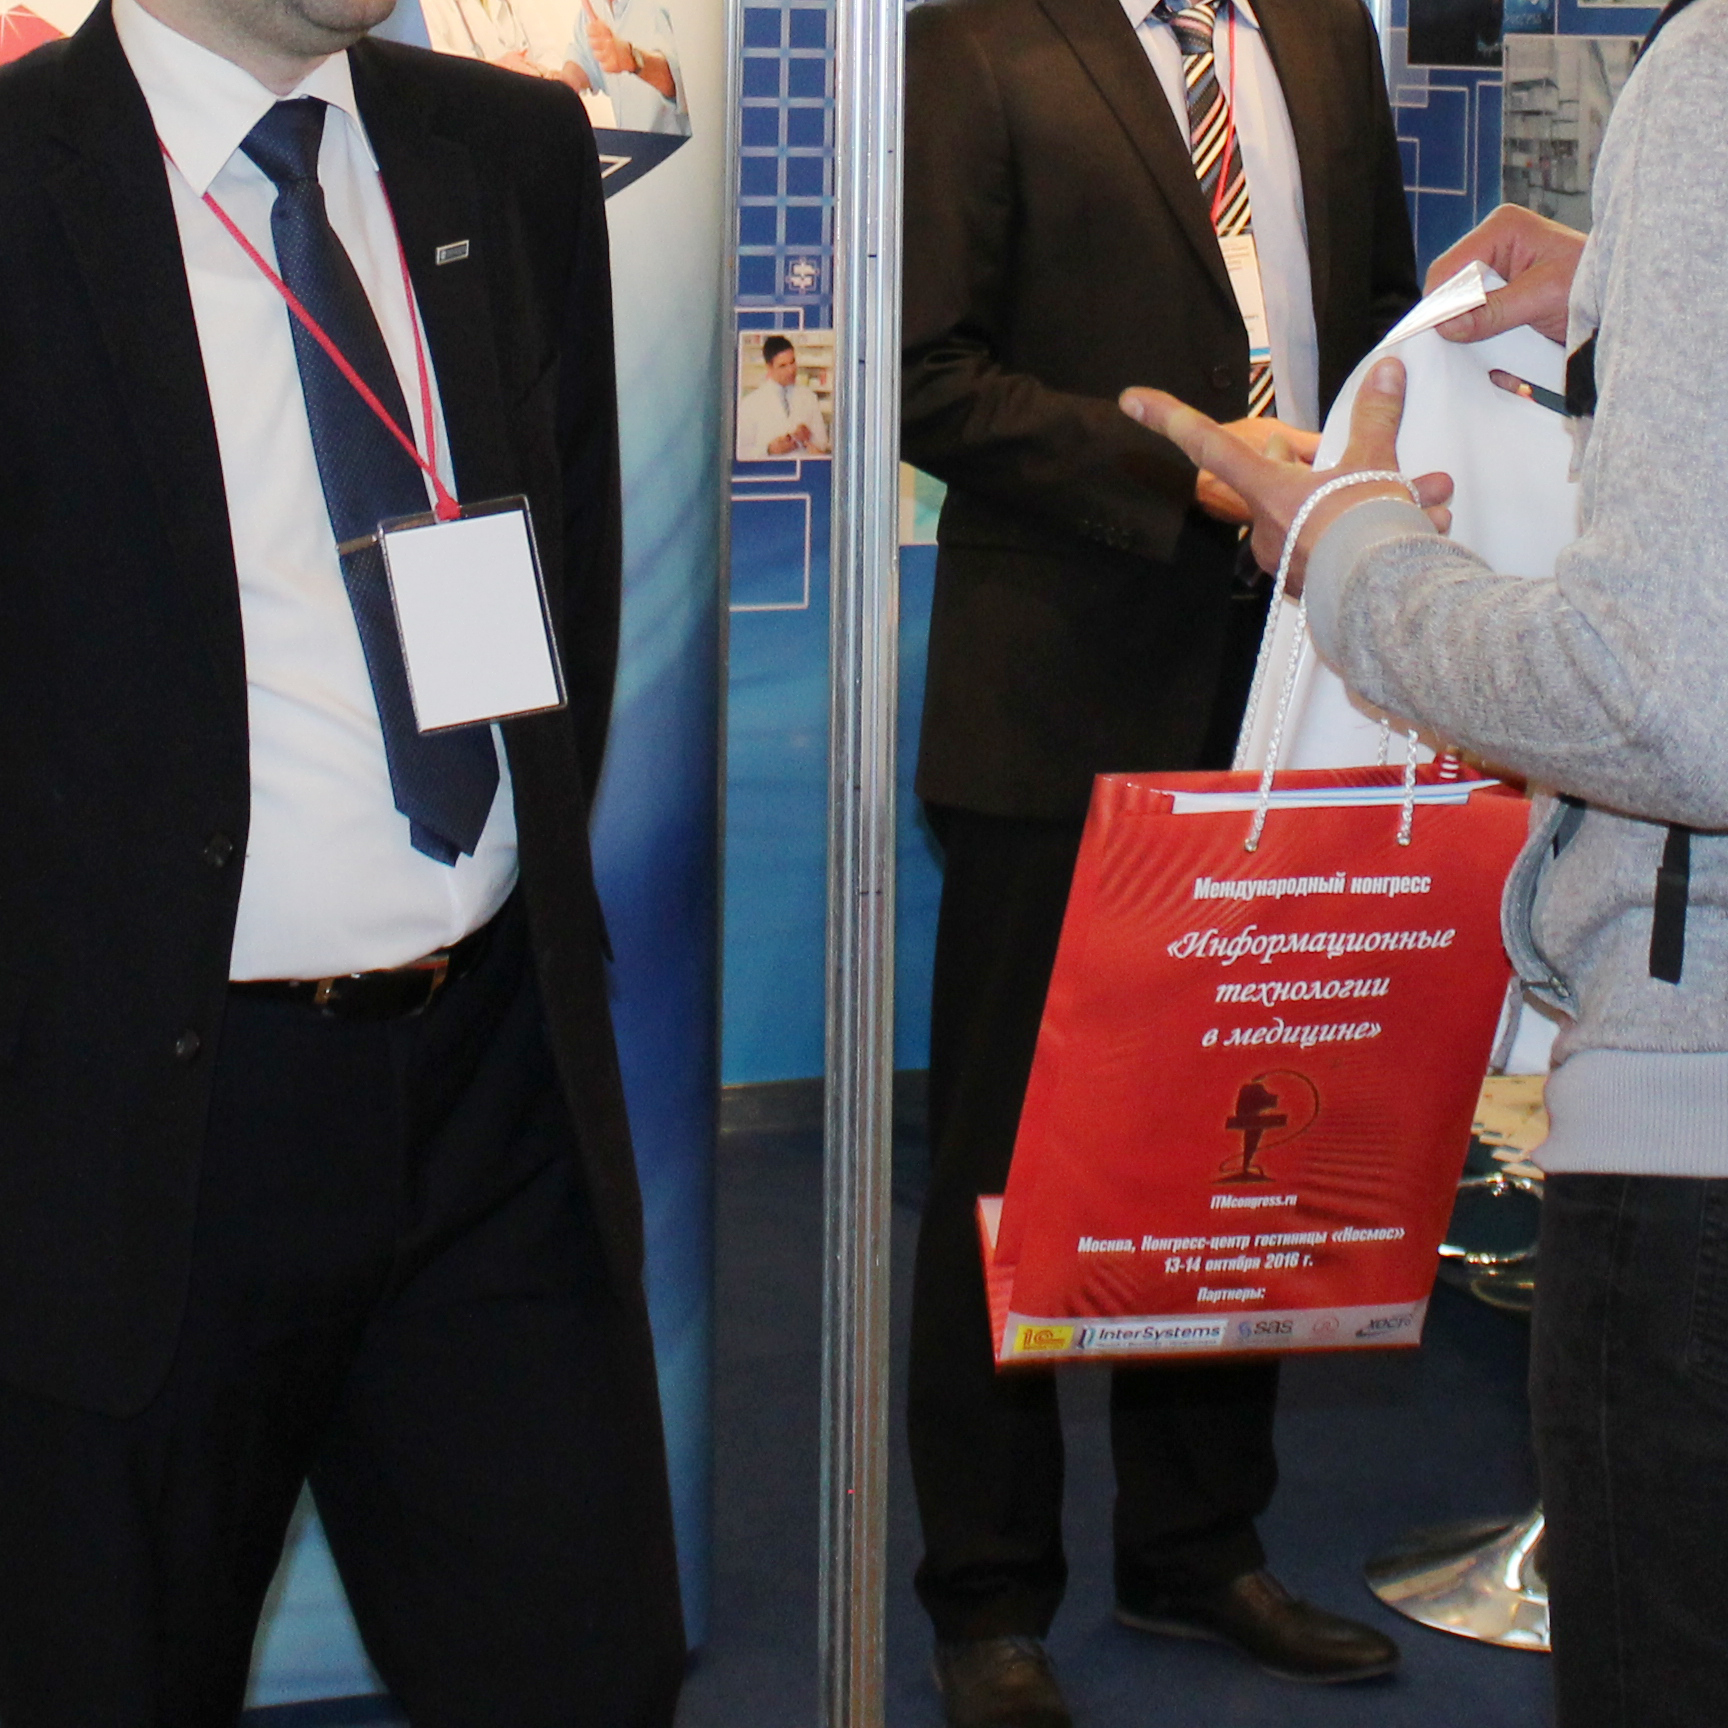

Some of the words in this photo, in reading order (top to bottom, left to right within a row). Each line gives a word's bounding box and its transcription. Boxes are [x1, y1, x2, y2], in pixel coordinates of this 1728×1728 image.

[1194, 872, 1346, 900] Международный
[1351, 876, 1432, 897] конгресс
[1167, 925, 1456, 966] «Информационные
[1215, 978, 1390, 1007] технологии
[1202, 1028, 1219, 1047] в
[1223, 1017, 1382, 1049] медицине»
[1210, 1195, 1297, 1210] ITMcongress.ru
[1077, 1237, 1136, 1253] Москва,
[1141, 1234, 1250, 1252] Конгресс-центр
[1255, 1231, 1327, 1246] гостиницы
[1165, 1256, 1201, 1273] 13-14
[1205, 1256, 1260, 1272] октября
[1197, 1286, 1265, 1302] Партнеры:
[1099, 1325, 1221, 1341] InterSystems
